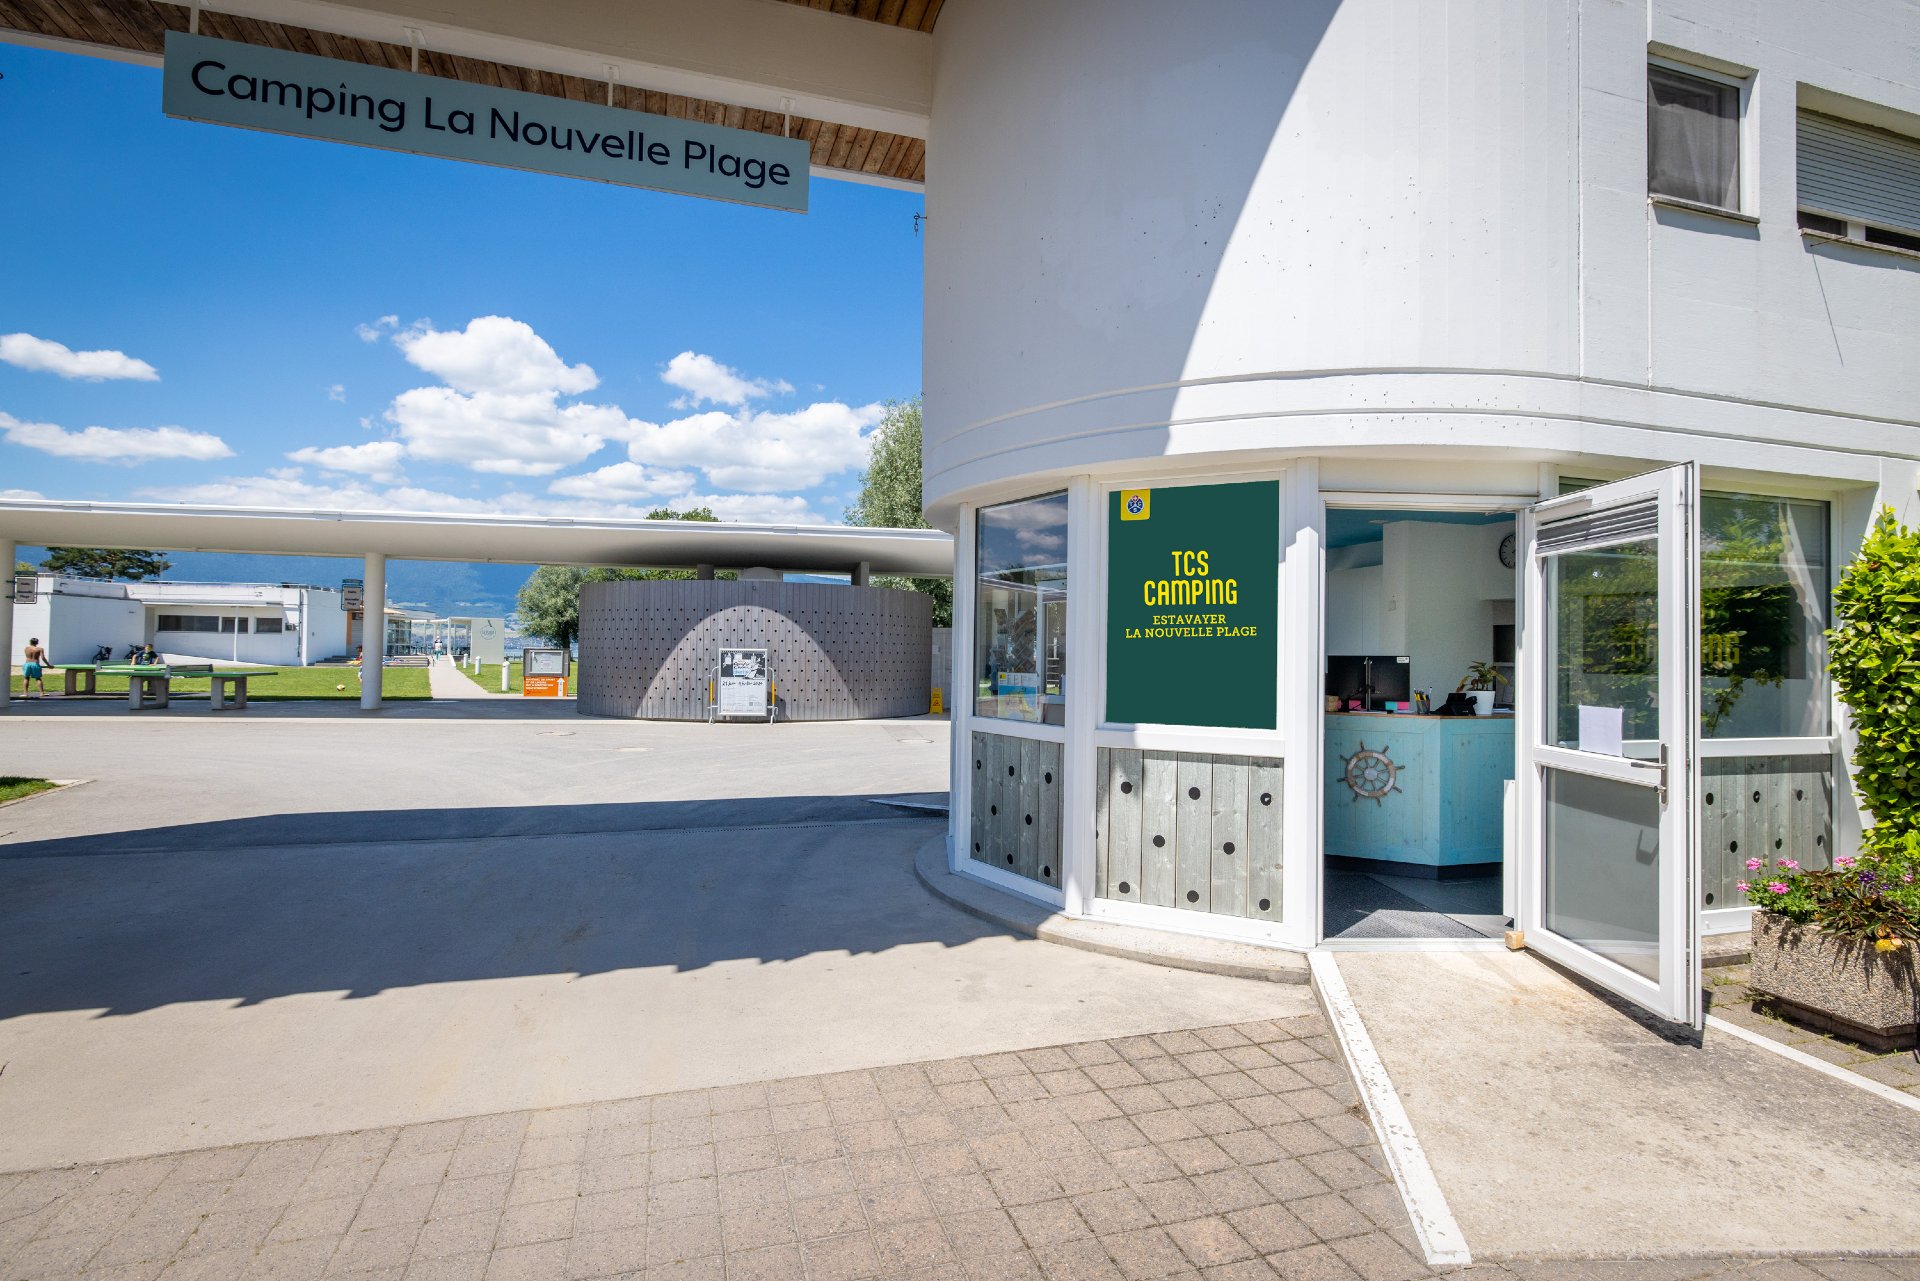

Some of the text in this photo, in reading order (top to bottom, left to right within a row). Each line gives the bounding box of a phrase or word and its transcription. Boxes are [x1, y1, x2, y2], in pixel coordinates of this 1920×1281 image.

[424, 97, 475, 136] La
[490, 108, 671, 166] Nouvelle
[684, 140, 791, 189] Plage
[1171, 551, 1209, 577] TCS
[1143, 578, 1238, 606] CAMPING
[1125, 626, 1258, 639] LA NOUVELLE PLAGE
[1152, 614, 1227, 625] ESTAVAYER
